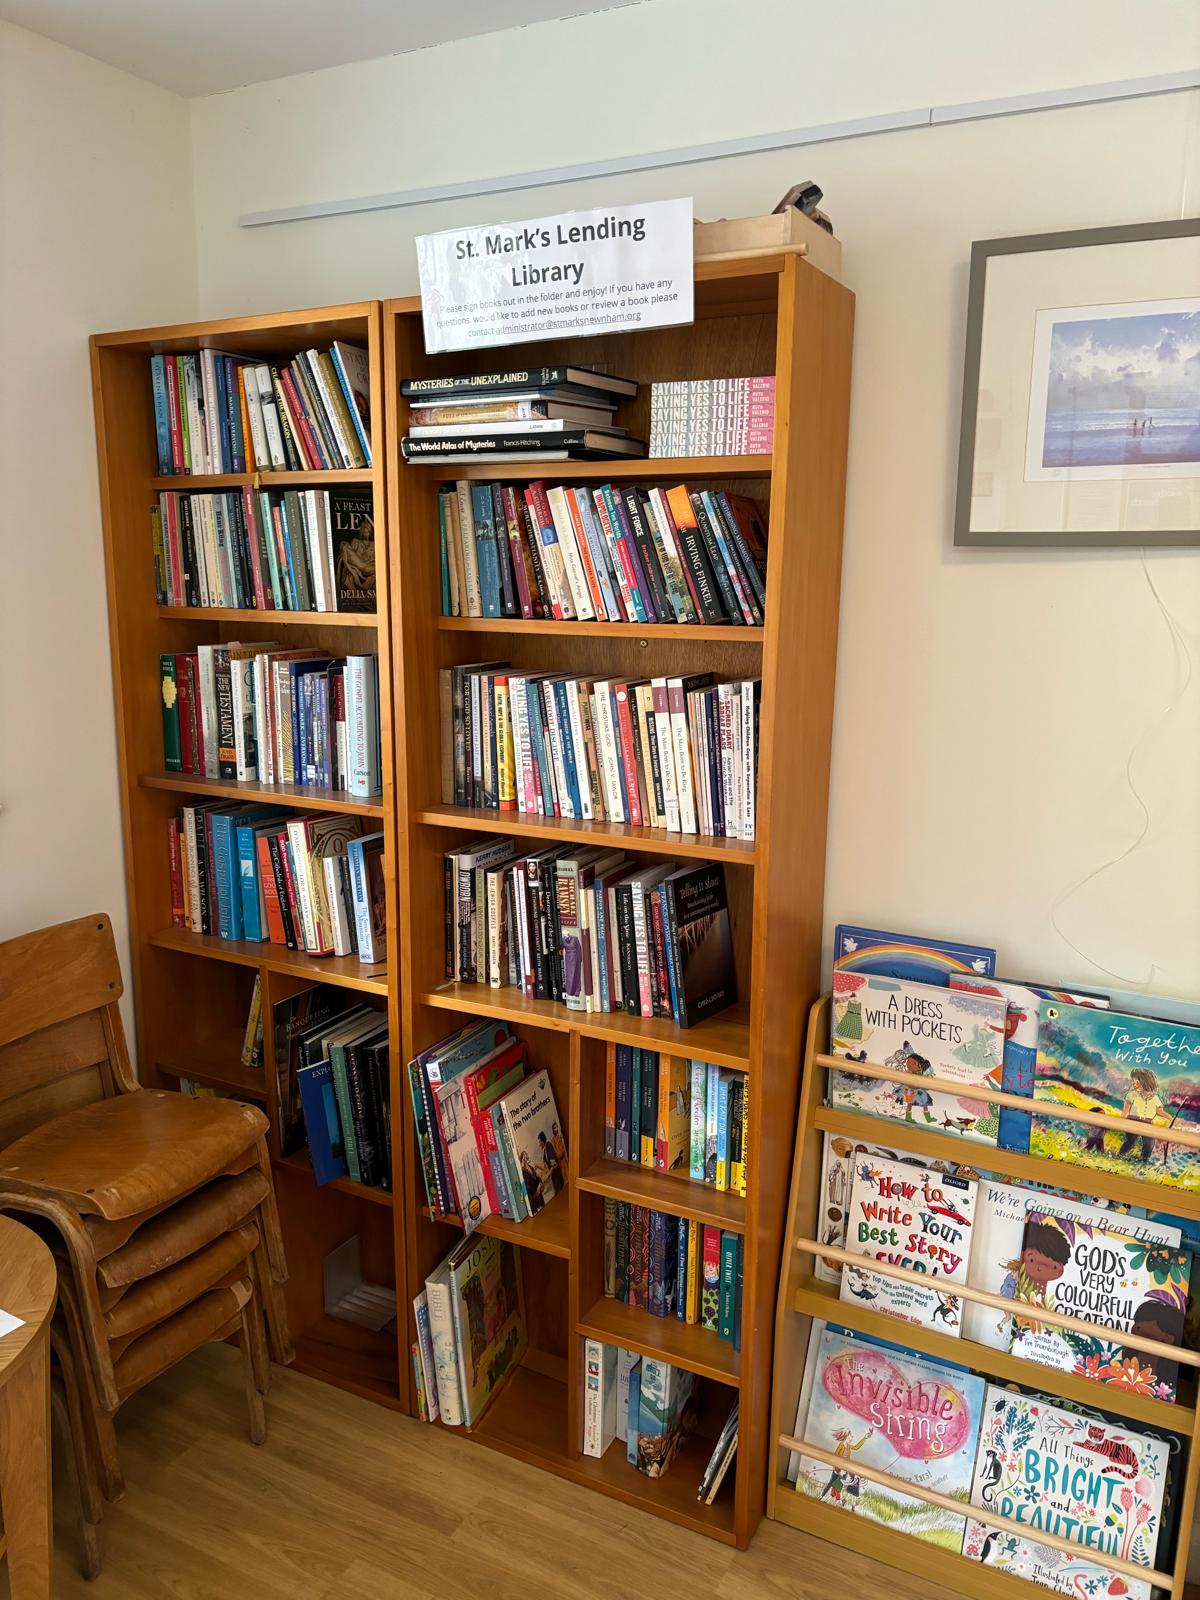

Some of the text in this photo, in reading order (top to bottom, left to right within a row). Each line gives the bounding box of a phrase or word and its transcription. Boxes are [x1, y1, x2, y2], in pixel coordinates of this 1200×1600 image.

[456, 216, 646, 260] St. Mark's Lending
[512, 263, 584, 286] Library
[480, 300, 501, 308] books
[503, 298, 516, 306] out
[526, 294, 538, 304] the
[540, 290, 562, 302] folder
[566, 288, 580, 299] and
[583, 286, 608, 298] enjoy!
[609, 284, 615, 294] If
[617, 284, 632, 296] you
[636, 280, 654, 290] have
[657, 280, 672, 290] any
[520, 308, 535, 318] add
[537, 307, 552, 316] new
[555, 303, 579, 314] books
[580, 303, 590, 311] or
[592, 299, 618, 310] review
[628, 294, 649, 306] book
[651, 292, 678, 305] please
[468, 326, 494, 337] contact
[410, 378, 454, 390] MYSTERIES
[471, 372, 528, 386] UNEXPLAINED
[652, 382, 688, 395] SAYING
[691, 380, 710, 394] YES
[712, 379, 726, 392] TO
[728, 378, 750, 391] LIFE
[651, 404, 750, 420] SAYING YES TO LIFE
[652, 391, 750, 408] SAYING YES TO LIFE
[650, 430, 748, 446] SAYING YES TO LIFE
[651, 418, 748, 434] SAYING YES TO LIFE
[409, 444, 420, 452] The
[421, 442, 440, 451] World
[442, 441, 458, 450] Atlas
[458, 440, 464, 449] of
[466, 440, 496, 450] Mysteries
[649, 444, 747, 458] SAYING YES TO LIFE
[334, 502, 371, 512] A FEAST
[595, 494, 612, 536] UNAPOLOGETIC
[626, 495, 644, 538] LIGHT FORCE
[336, 512, 374, 530] LEN
[720, 498, 750, 563] DETHRONING MAMMON
[527, 524, 540, 572] CHRISTIANITY
[699, 512, 718, 562] QUANTUM LEAP
[686, 535, 712, 606] IRVING FINKEL
[340, 590, 365, 599] DELIA
[516, 679, 527, 716] SAYING
[544, 684, 554, 726] BAREFOOT
[220, 692, 234, 746] TESTAMENT
[520, 717, 528, 736] YES
[522, 738, 530, 750] TO
[522, 752, 532, 770] LIFE
[558, 878, 570, 916] RAMSEY
[632, 881, 648, 974] SAYING YES TO LIFE
[888, 994, 943, 1020] A DRESS
[866, 1008, 962, 1044] WITH POCKETS
[1109, 1025, 1200, 1053] Togethe
[1116, 1048, 1188, 1067] With You
[510, 1090, 538, 1119] The story of
[513, 1096, 551, 1131] the two brothers
[878, 1176, 944, 1203] How to
[944, 1178, 967, 1188] OXFORD
[860, 1200, 962, 1245] Write Your
[988, 1189, 1170, 1246] We're Going on a Bear Hunt
[994, 1208, 1025, 1222] Michae
[858, 1222, 900, 1246] Best
[905, 1234, 963, 1274] Story
[1074, 1244, 1127, 1278] GOD'S
[872, 1275, 934, 1300] Top tips trade secrets
[1080, 1270, 1115, 1294] VERY
[891, 1300, 911, 1308] experts
[896, 1292, 928, 1308] Oxford word
[1055, 1282, 1134, 1320] COLOURFUL
[880, 1306, 922, 1325] Christopher Edge
[846, 1358, 864, 1372] The
[834, 1364, 954, 1421] Invisible
[870, 1402, 948, 1453] String
[1039, 1437, 1094, 1468] All Things
[1024, 1448, 1126, 1509] BRIGHT
[1050, 1498, 1070, 1513] and
[1066, 1576, 1073, 1590] by
